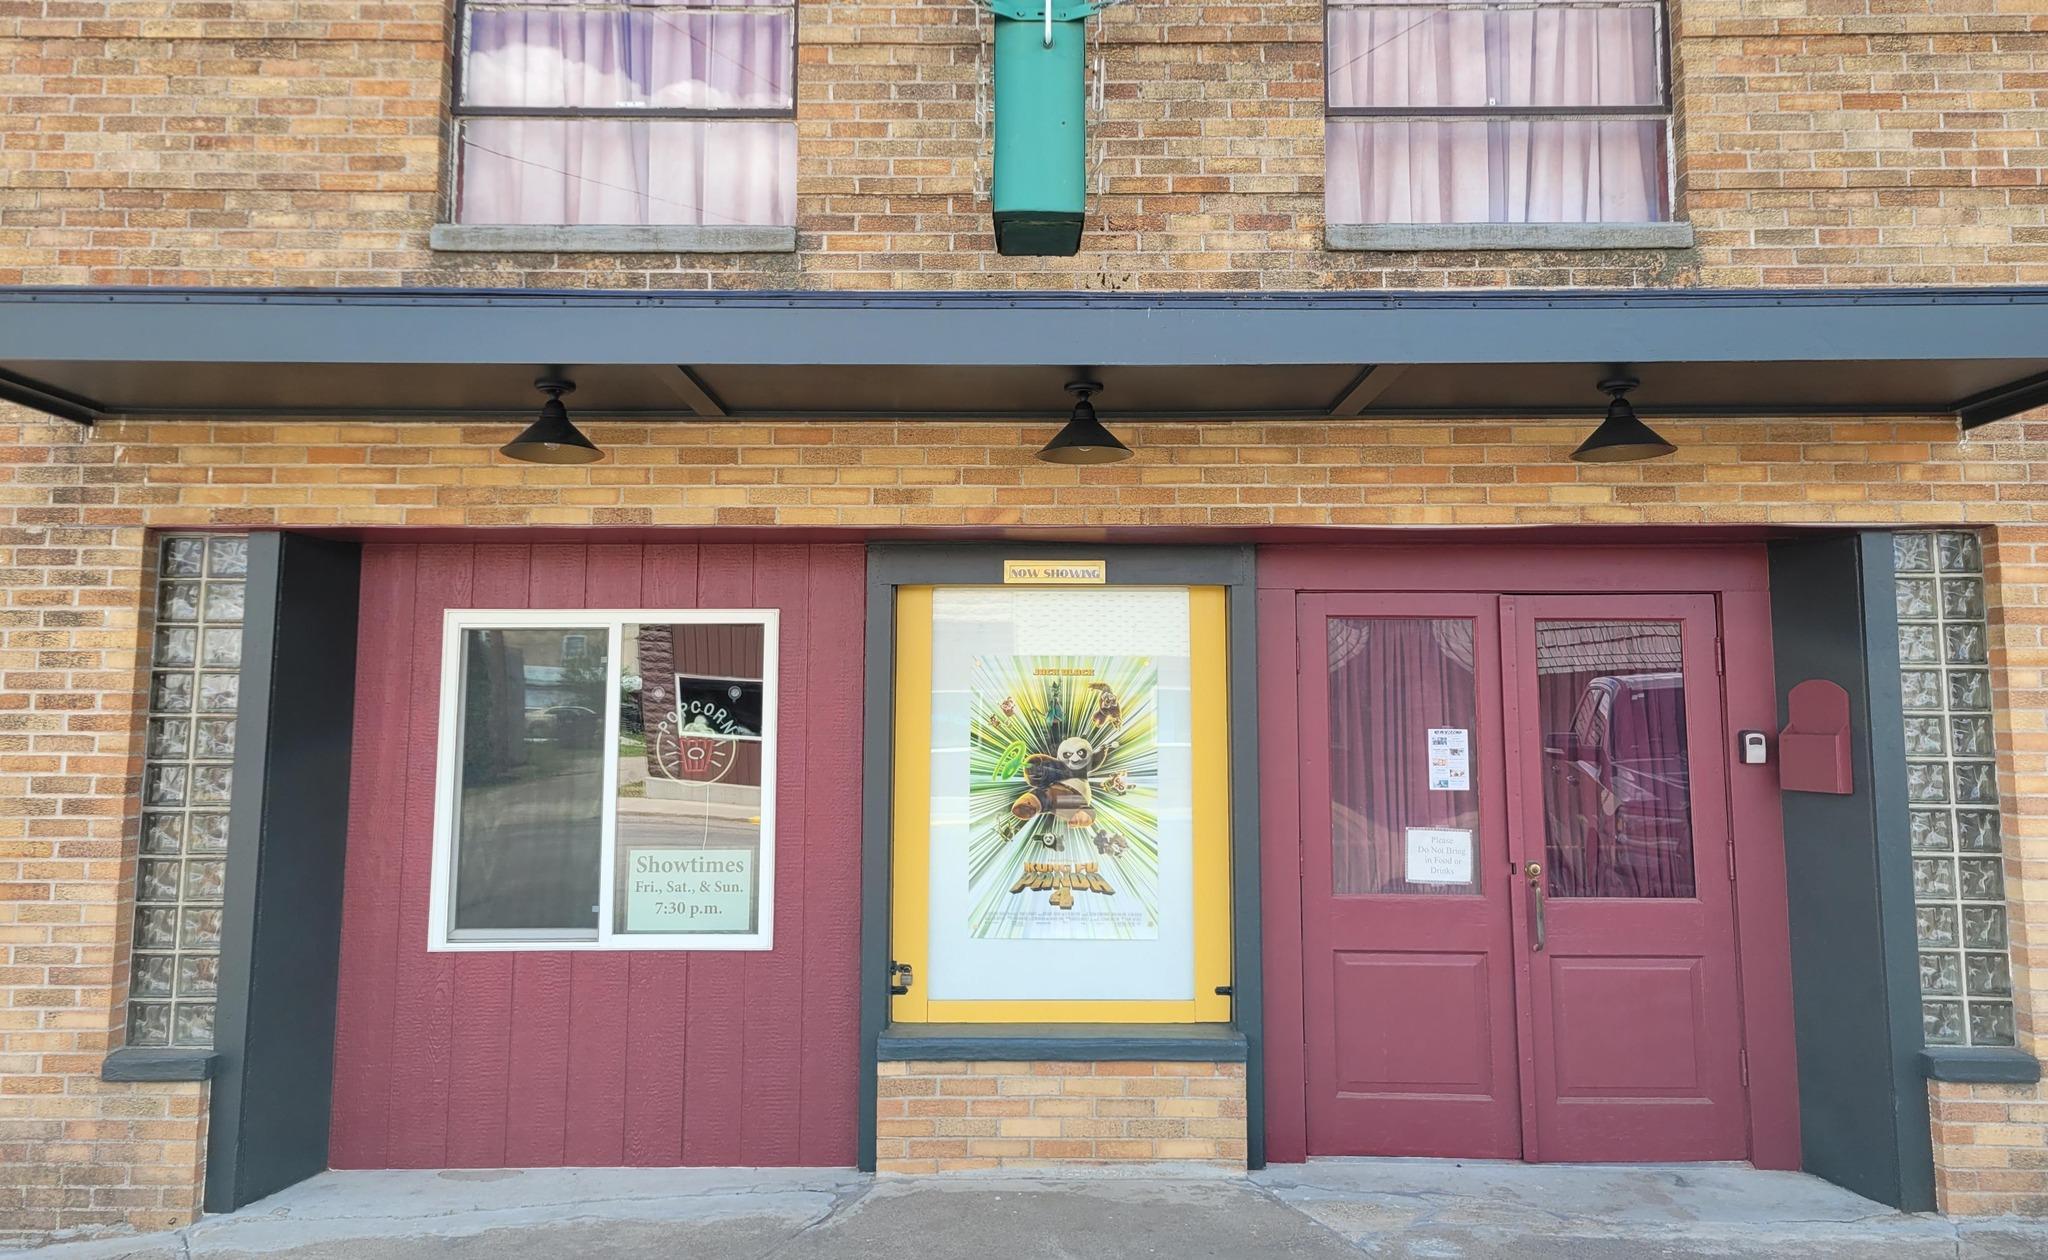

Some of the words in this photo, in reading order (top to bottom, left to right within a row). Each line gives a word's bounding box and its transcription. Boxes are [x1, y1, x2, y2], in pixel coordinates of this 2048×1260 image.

[1011, 568, 1040, 578] NOW
[1043, 568, 1100, 578] SHOWING
[658, 700, 738, 735] POPCORN
[1417, 846, 1429, 854] Do
[636, 856, 744, 873] Showtimes
[1024, 862, 1071, 873] KUNG
[1074, 862, 1099, 873] FU
[635, 881, 662, 894] Fri.,
[666, 881, 695, 894] Sat.,
[699, 881, 711, 892] &
[714, 881, 744, 892] Sun.
[1009, 872, 1116, 895] PANDA
[1049, 888, 1074, 910] 4
[655, 902, 686, 914] 7:30
[689, 904, 722, 918] p.m.
